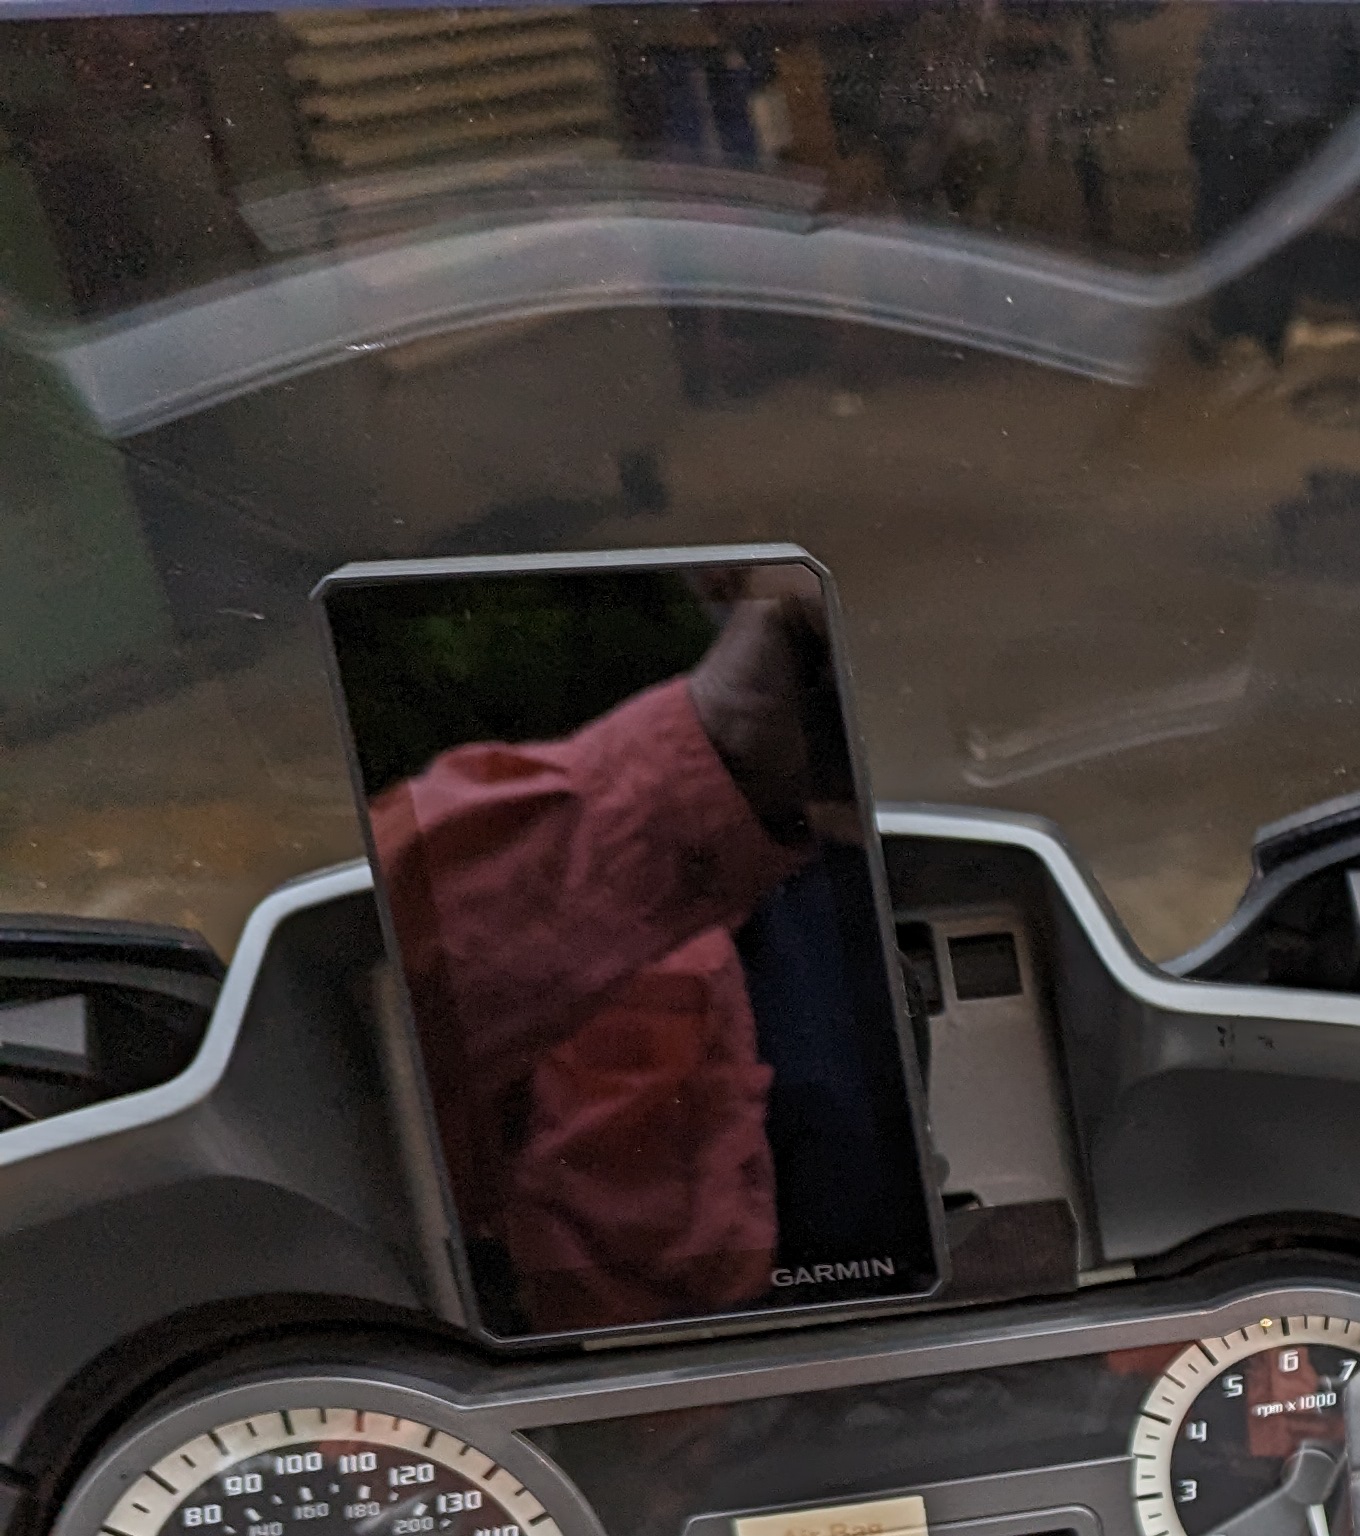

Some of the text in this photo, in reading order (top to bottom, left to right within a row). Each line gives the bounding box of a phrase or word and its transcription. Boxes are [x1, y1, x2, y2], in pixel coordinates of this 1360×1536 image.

[771, 1257, 895, 1287] GARMIN
[1279, 1351, 1299, 1373] 6
[1338, 1359, 1358, 1381] 7
[1222, 1375, 1243, 1398] 5
[1255, 1392, 1337, 1418] rpm x 1000
[1187, 1421, 1207, 1442] 4
[275, 1451, 323, 1475] 100
[339, 1452, 377, 1474] 110
[224, 1473, 263, 1496] 90
[389, 1463, 435, 1487] 120
[437, 1490, 482, 1514] 130
[1179, 1479, 1197, 1502] 3
[183, 1504, 222, 1527] 80
[294, 1503, 329, 1520] 160
[345, 1501, 380, 1519] 180
[393, 1516, 434, 1535] 200
